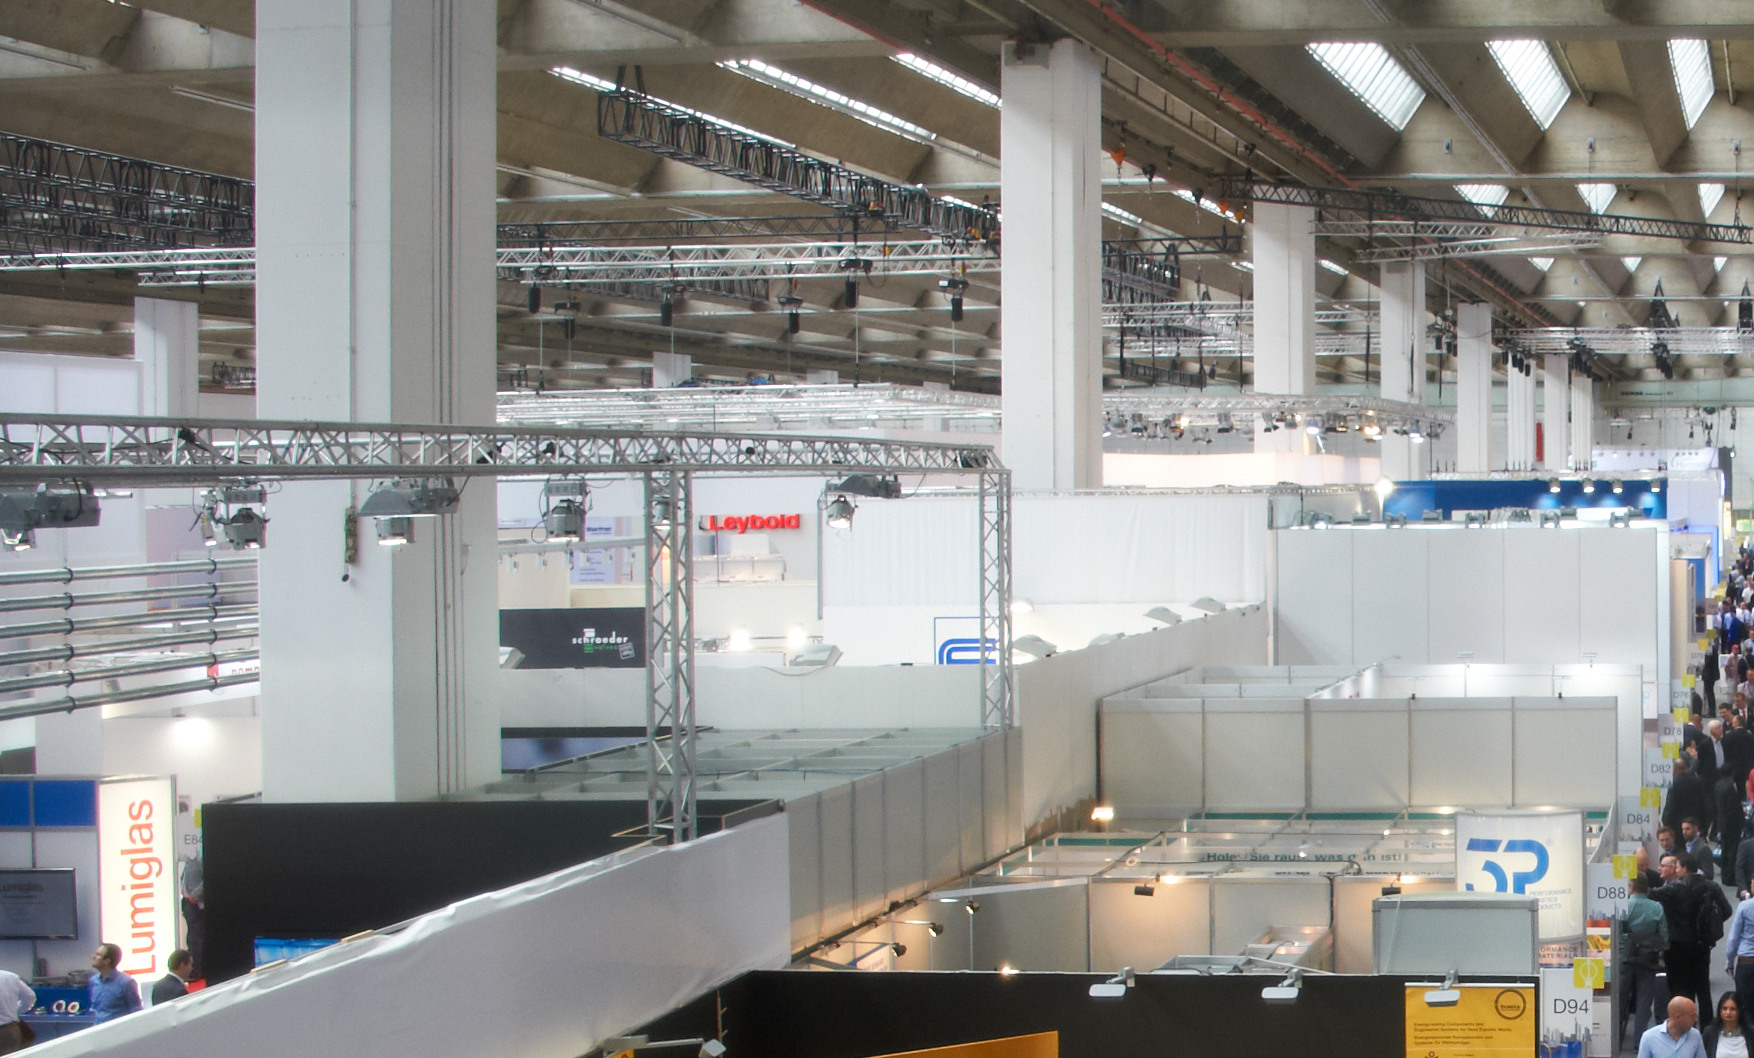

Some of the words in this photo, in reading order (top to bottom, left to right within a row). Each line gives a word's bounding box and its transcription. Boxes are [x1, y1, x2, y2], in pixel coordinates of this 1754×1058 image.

[709, 514, 801, 534] Leybold
[1650, 763, 1672, 774] D82
[1626, 813, 1651, 825] D84
[120, 799, 163, 977] Lumiglas
[1597, 886, 1626, 899] D88
[1540, 945, 1579, 953] ORMANCE
[1553, 998, 1589, 1014] D94
